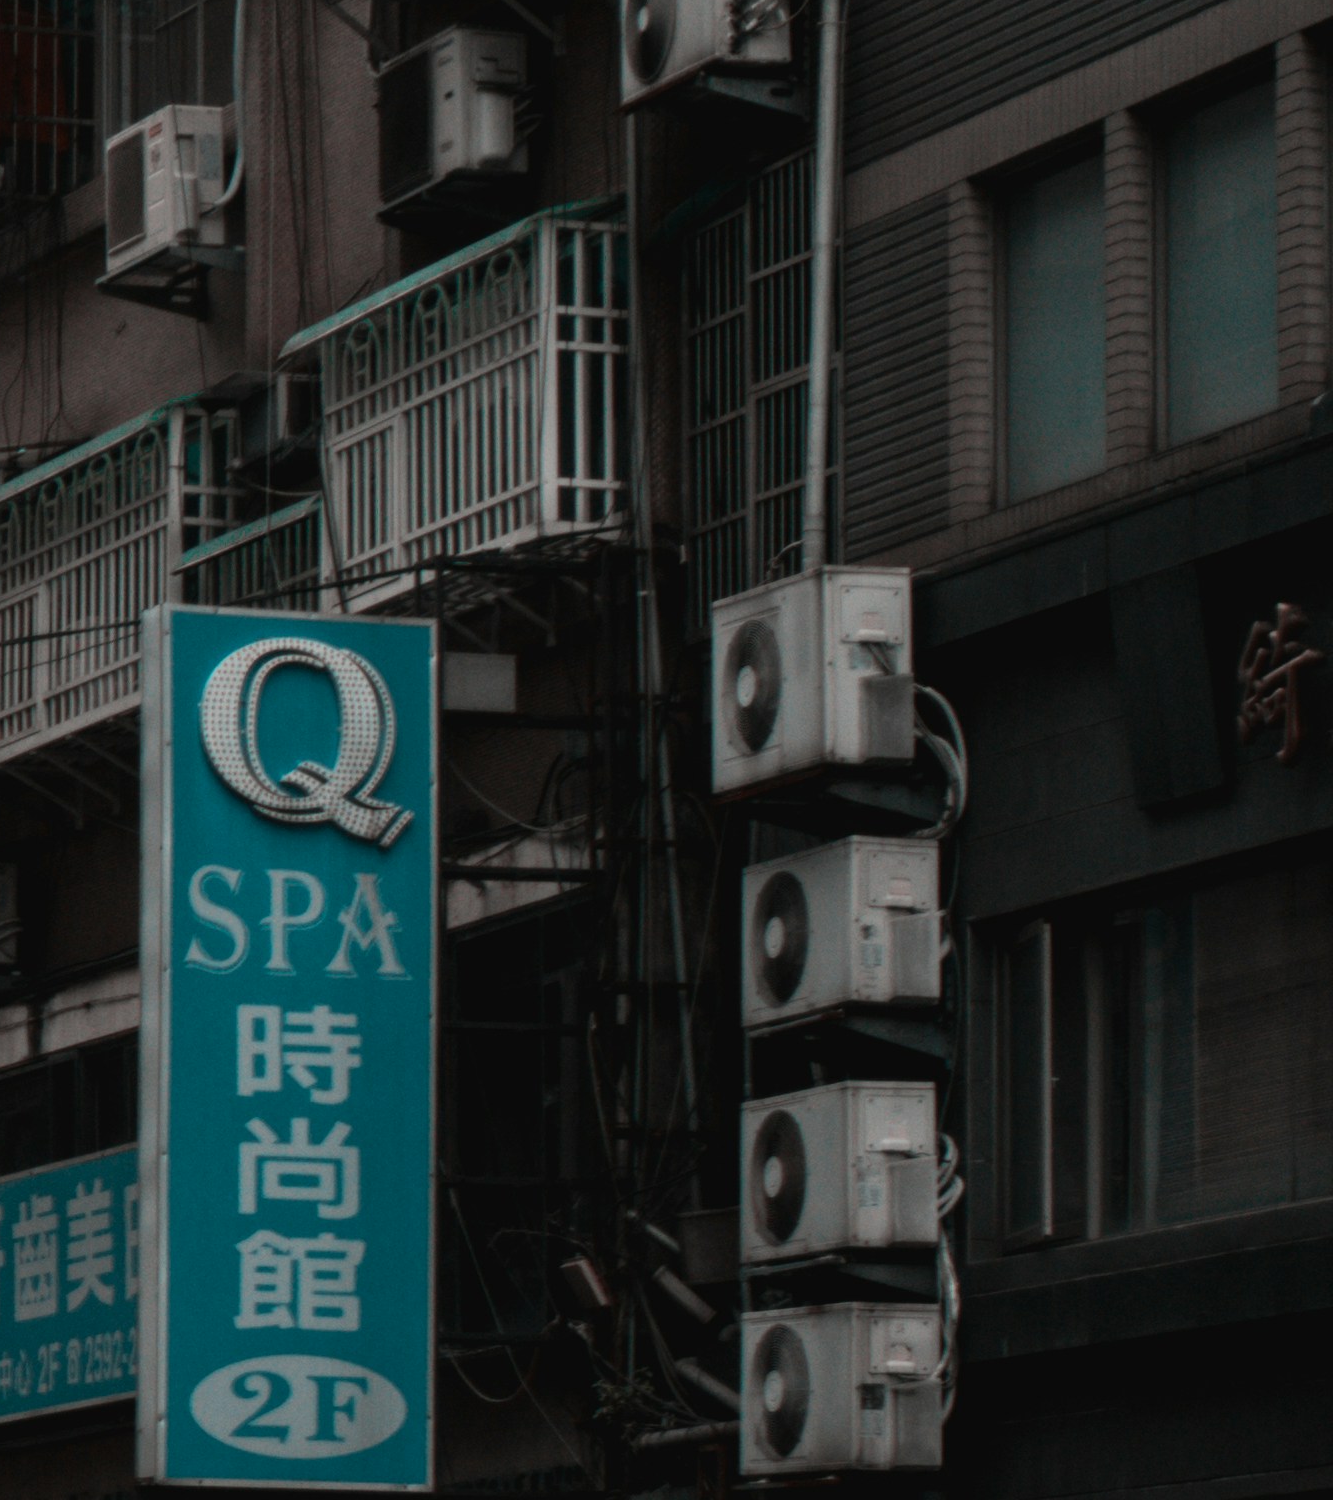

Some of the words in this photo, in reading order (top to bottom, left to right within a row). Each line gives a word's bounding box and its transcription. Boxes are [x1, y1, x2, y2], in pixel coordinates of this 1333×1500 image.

[199, 635, 416, 852] Q
[184, 863, 413, 981] SPA
[233, 1003, 367, 1334] 時尚館
[37, 1340, 62, 1395] 2F
[229, 1372, 369, 1444] 2F
